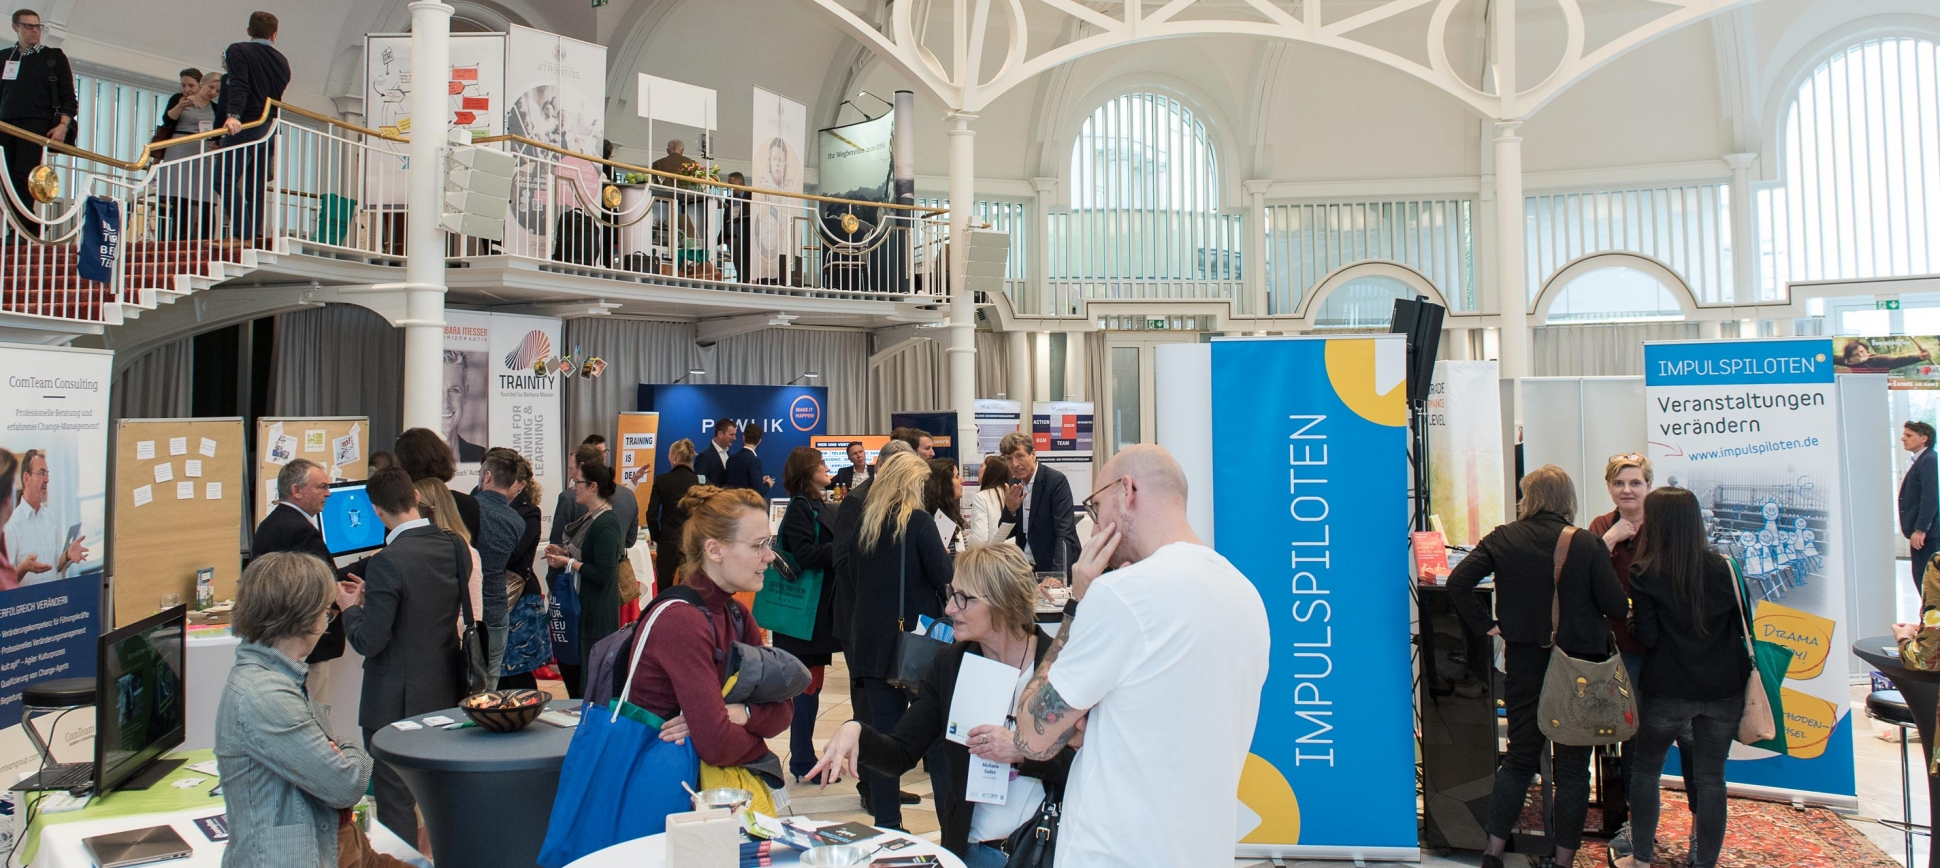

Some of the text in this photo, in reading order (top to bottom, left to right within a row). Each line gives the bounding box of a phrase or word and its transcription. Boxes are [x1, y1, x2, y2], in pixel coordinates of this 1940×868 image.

[462, 327, 488, 337] MESSER
[1658, 357, 1815, 376] IMPULSPILOTEN
[9, 376, 98, 392] ComTeam Consulting
[499, 375, 555, 390] TRAINITY
[523, 405, 533, 415] &
[1658, 392, 1825, 413] Veranstaltungen
[15, 408, 93, 418] Professionelle Beratung und
[512, 405, 522, 429] FOR
[7, 422, 100, 432] erfahrenes Change-Management!
[702, 418, 784, 434] PWIK
[1660, 417, 1760, 436] verändern
[534, 414, 544, 477] LEARNING
[625, 436, 653, 446] TRAINING
[1688, 436, 1819, 461] www.impulspiloten.de
[625, 454, 632, 463] IS
[1289, 414, 1334, 767] IMPULSPILOTEN
[36, 595, 69, 610] VERÄNDERN
[1, 619, 53, 638] Veränderungskompetenz
[553, 633, 569, 643] TEL
[1, 640, 33, 655] Professionelles
[24, 655, 38, 666] Agiler
[38, 648, 66, 661] Kulturprozess
[1, 662, 70, 689] Qualifizierung von Change-Agents
[65, 725, 95, 742] ComTeam
